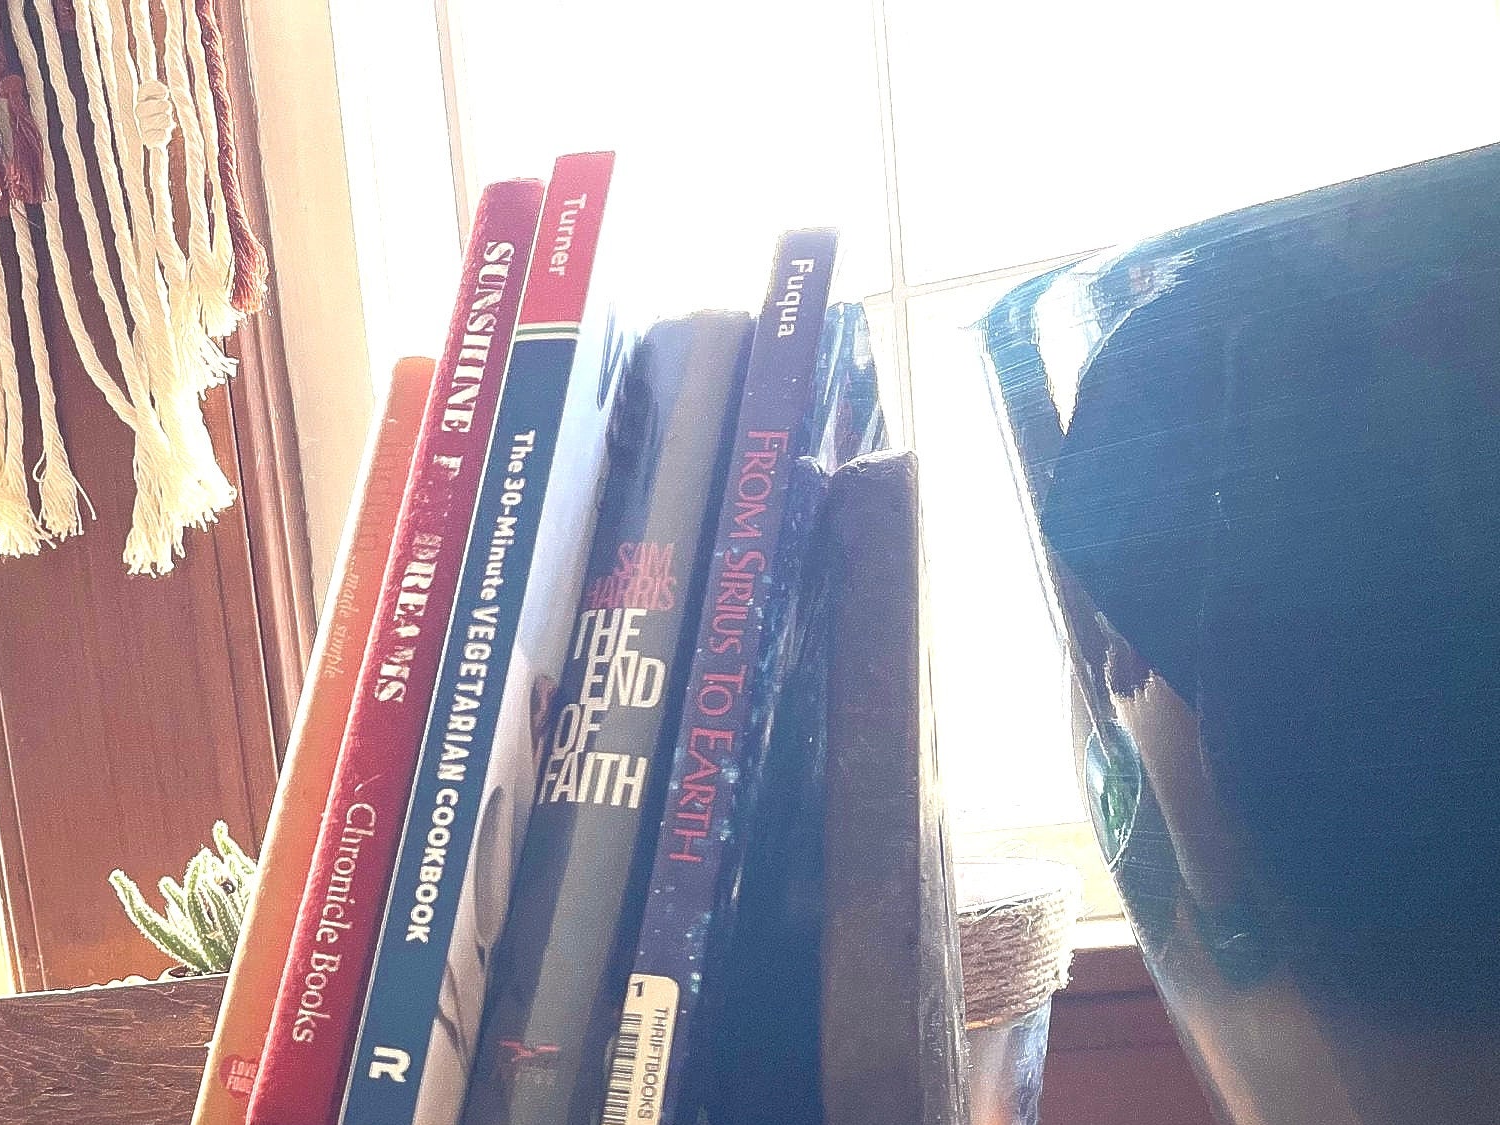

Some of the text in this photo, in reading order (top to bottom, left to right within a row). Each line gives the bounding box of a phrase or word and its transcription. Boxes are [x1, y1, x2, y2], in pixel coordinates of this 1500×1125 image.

[549, 193, 587, 276] Turner
[441, 241, 515, 433] SUNSHINE
[776, 259, 814, 338] Fuqua
[573, 608, 647, 660] THE
[669, 430, 789, 863] FROM SIRIUS TO EARTH
[405, 430, 536, 944] The 30-Minute VEGETARIAN COOKBOOK
[579, 654, 667, 710] END
[552, 704, 606, 760] OF
[538, 751, 649, 810] FAITH
[292, 802, 378, 1044] Chronicle Books
[637, 1008, 670, 1120] THRIFTBOOKS
